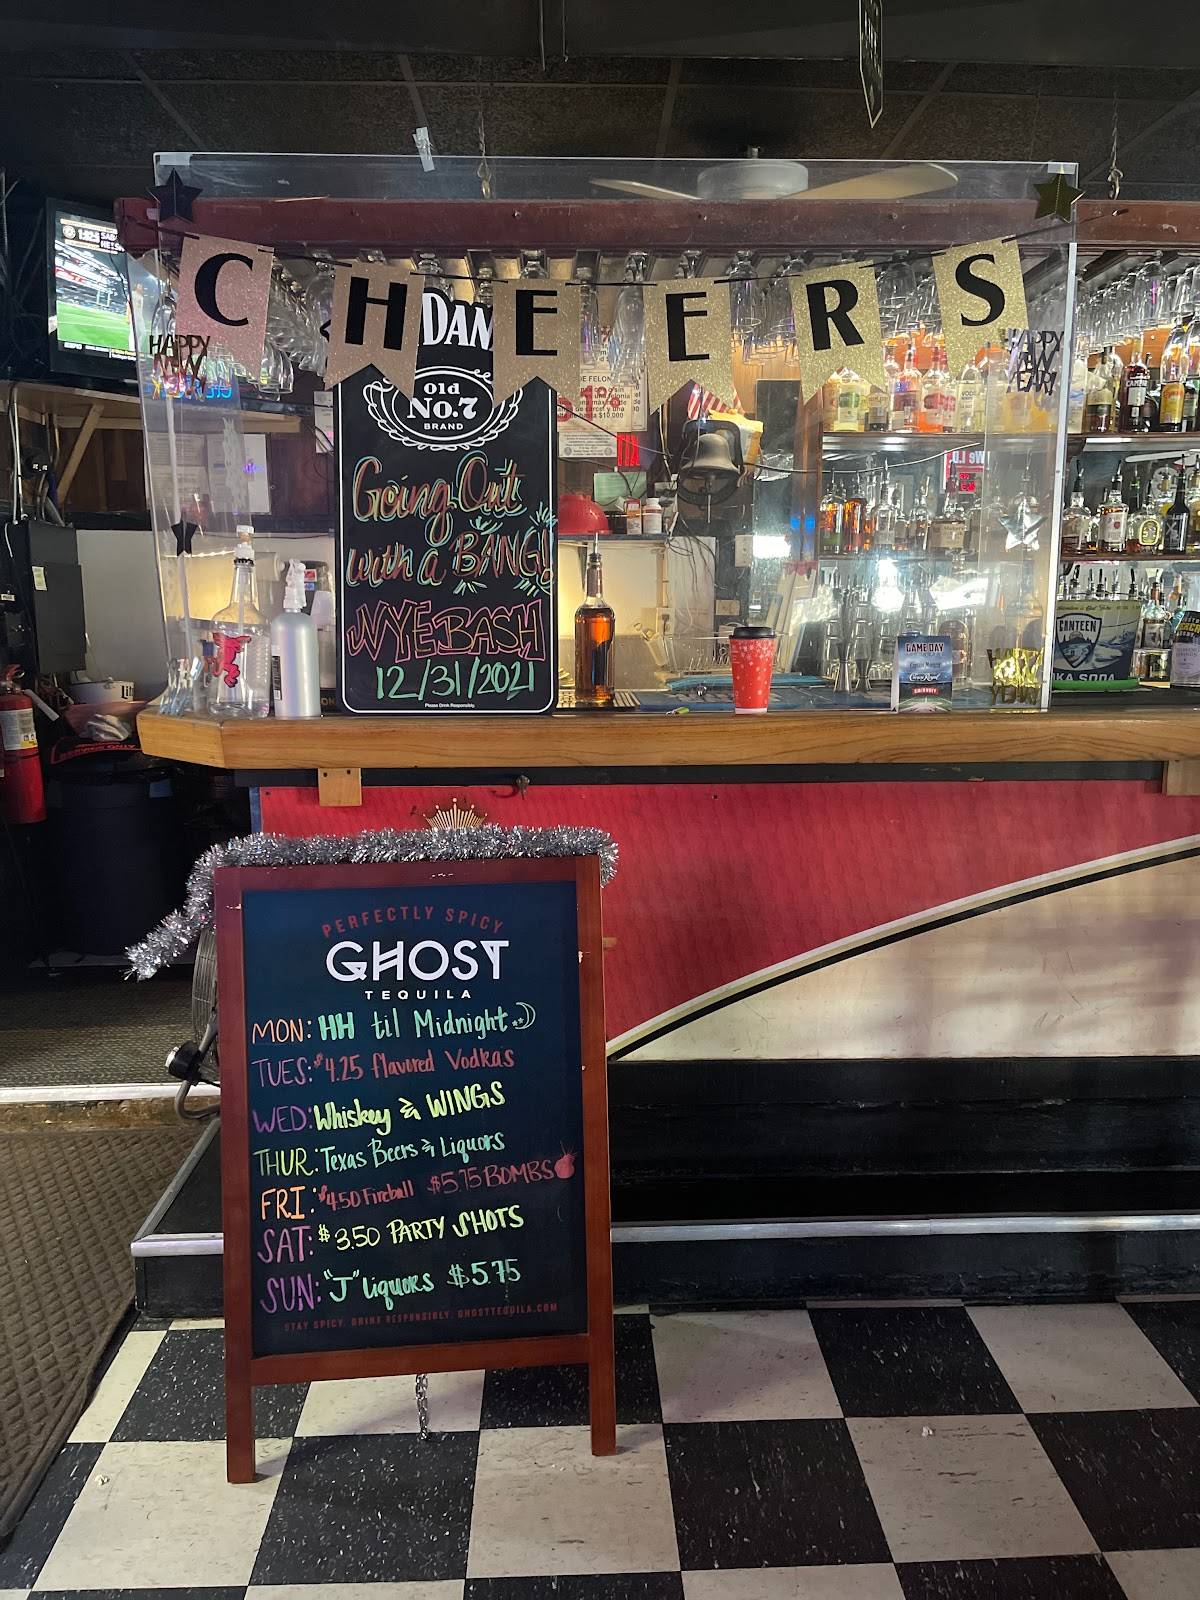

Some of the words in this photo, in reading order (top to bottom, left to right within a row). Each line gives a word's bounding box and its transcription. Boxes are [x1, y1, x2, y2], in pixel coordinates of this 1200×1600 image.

[194, 252, 1006, 362] CHEERS
[149, 335, 211, 356] HAPPY
[406, 396, 479, 420] No.7
[423, 382, 461, 395] Old
[423, 422, 464, 431] BRAND
[353, 455, 453, 548] Going
[456, 450, 527, 516] Out
[346, 541, 414, 588] with
[417, 547, 447, 587] a
[451, 524, 555, 592] BANG!
[346, 598, 438, 664] NYE
[432, 599, 546, 662] BASH
[1059, 619, 1097, 632] CANTEEN
[905, 642, 927, 653] GAME
[928, 643, 945, 653] DAY
[376, 656, 535, 701] 12/31/2021
[321, 906, 434, 938] PERFECTLY
[445, 908, 503, 933] SPICY
[326, 939, 510, 982] GHOST
[364, 989, 472, 1000] TEQUILA
[252, 1018, 312, 1044] MON:
[318, 1011, 355, 1041] HH
[371, 1008, 400, 1040] til
[413, 1006, 508, 1040] Midnight
[251, 1057, 313, 1087] TUES:
[314, 1051, 364, 1082] $4.25
[445, 1048, 514, 1071] Vodkas
[253, 1105, 313, 1133] WED:
[313, 1098, 391, 1136] Whiskey
[425, 1080, 506, 1119] WINGS
[320, 1145, 367, 1173] Texas
[367, 1137, 419, 1168] Beers
[440, 1131, 505, 1164] Liquors
[260, 1186, 317, 1221] FRI:
[362, 1180, 415, 1205] Fireball
[427, 1167, 482, 1196] $5.75
[484, 1158, 555, 1188] BOMBS
[257, 1225, 314, 1264] SAT:
[386, 1216, 446, 1245] PARTY
[452, 1204, 525, 1239] SHOTS
[260, 1273, 322, 1314] SUN:
[446, 1258, 522, 1289] $5.75
[284, 1322, 309, 1333] STAY
[351, 1316, 380, 1327] DRINK
[457, 1302, 559, 1319] GHOSTTEQUILA.COM
